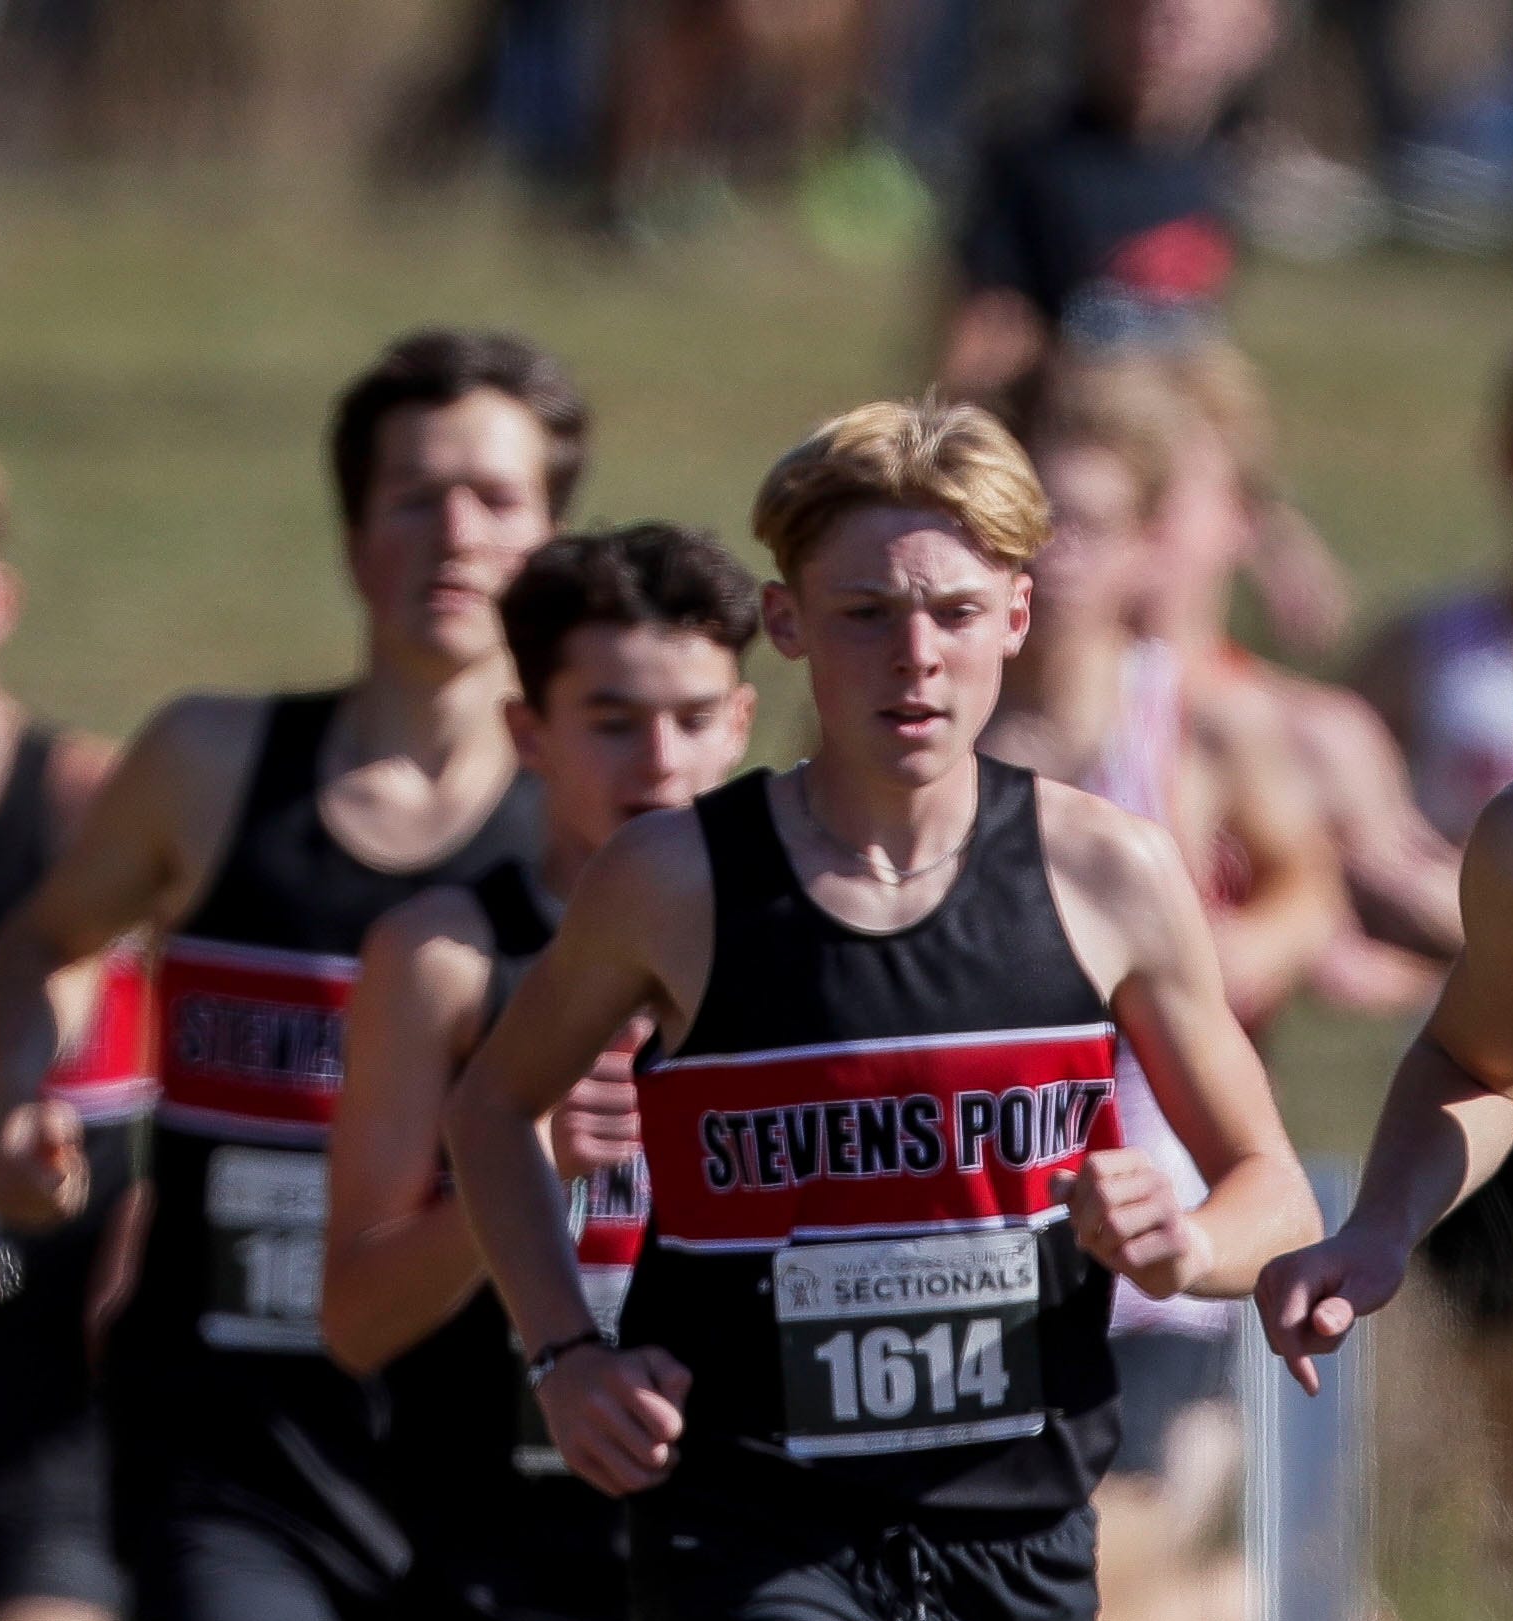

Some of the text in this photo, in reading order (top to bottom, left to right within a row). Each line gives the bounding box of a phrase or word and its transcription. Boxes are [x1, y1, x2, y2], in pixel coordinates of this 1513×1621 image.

[699, 1093, 947, 1193] STEVENS
[833, 1267, 1033, 1305] SECTIONALS
[815, 1317, 1010, 1422] 1614
